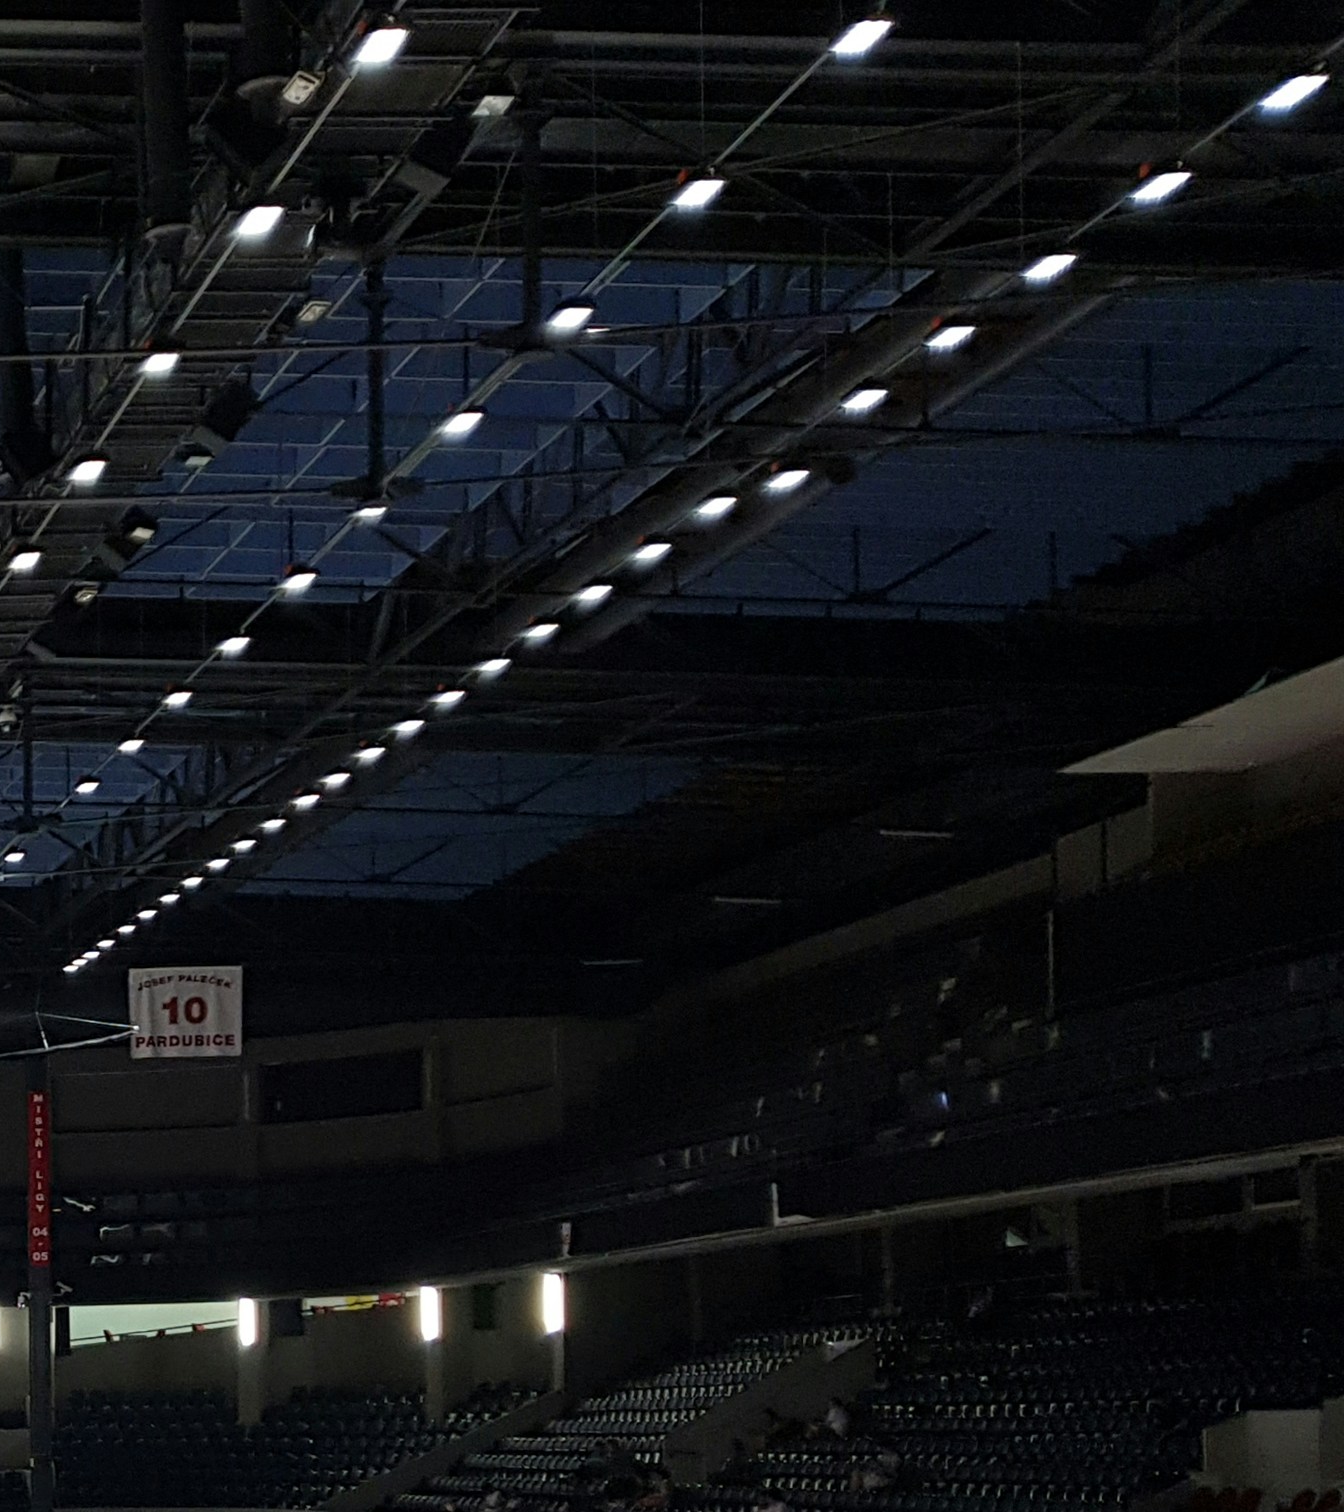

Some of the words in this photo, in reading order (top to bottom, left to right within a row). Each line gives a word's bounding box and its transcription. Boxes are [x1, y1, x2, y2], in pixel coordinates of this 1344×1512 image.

[137, 976, 174, 991] JOSEF
[162, 996, 207, 1025] 10
[135, 1034, 236, 1048] PARDUBICE
[35, 1169, 45, 1213] LIGY
[32, 1226, 49, 1238] 04
[32, 1251, 49, 1262] 05
